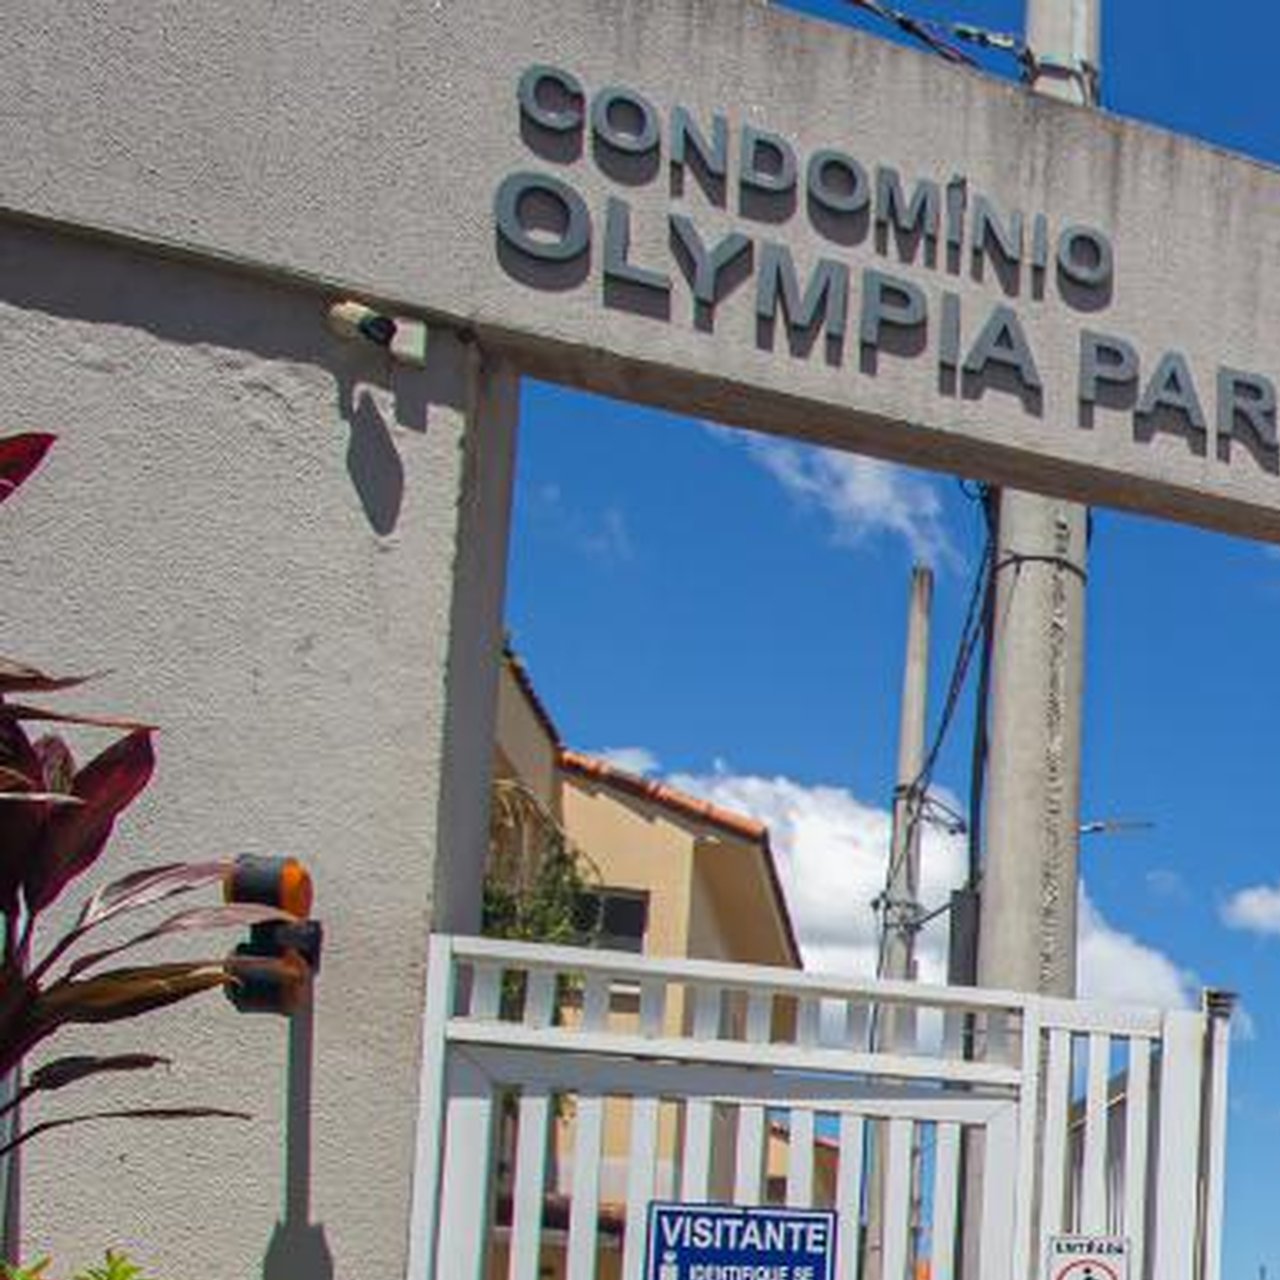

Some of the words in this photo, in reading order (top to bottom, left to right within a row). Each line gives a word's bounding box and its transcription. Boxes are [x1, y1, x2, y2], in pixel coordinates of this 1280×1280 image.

[494, 172, 1042, 392] OLYMPIA
[517, 63, 1112, 290] CONDOMÍNIO
[661, 1215, 826, 1254] VISITANTE
